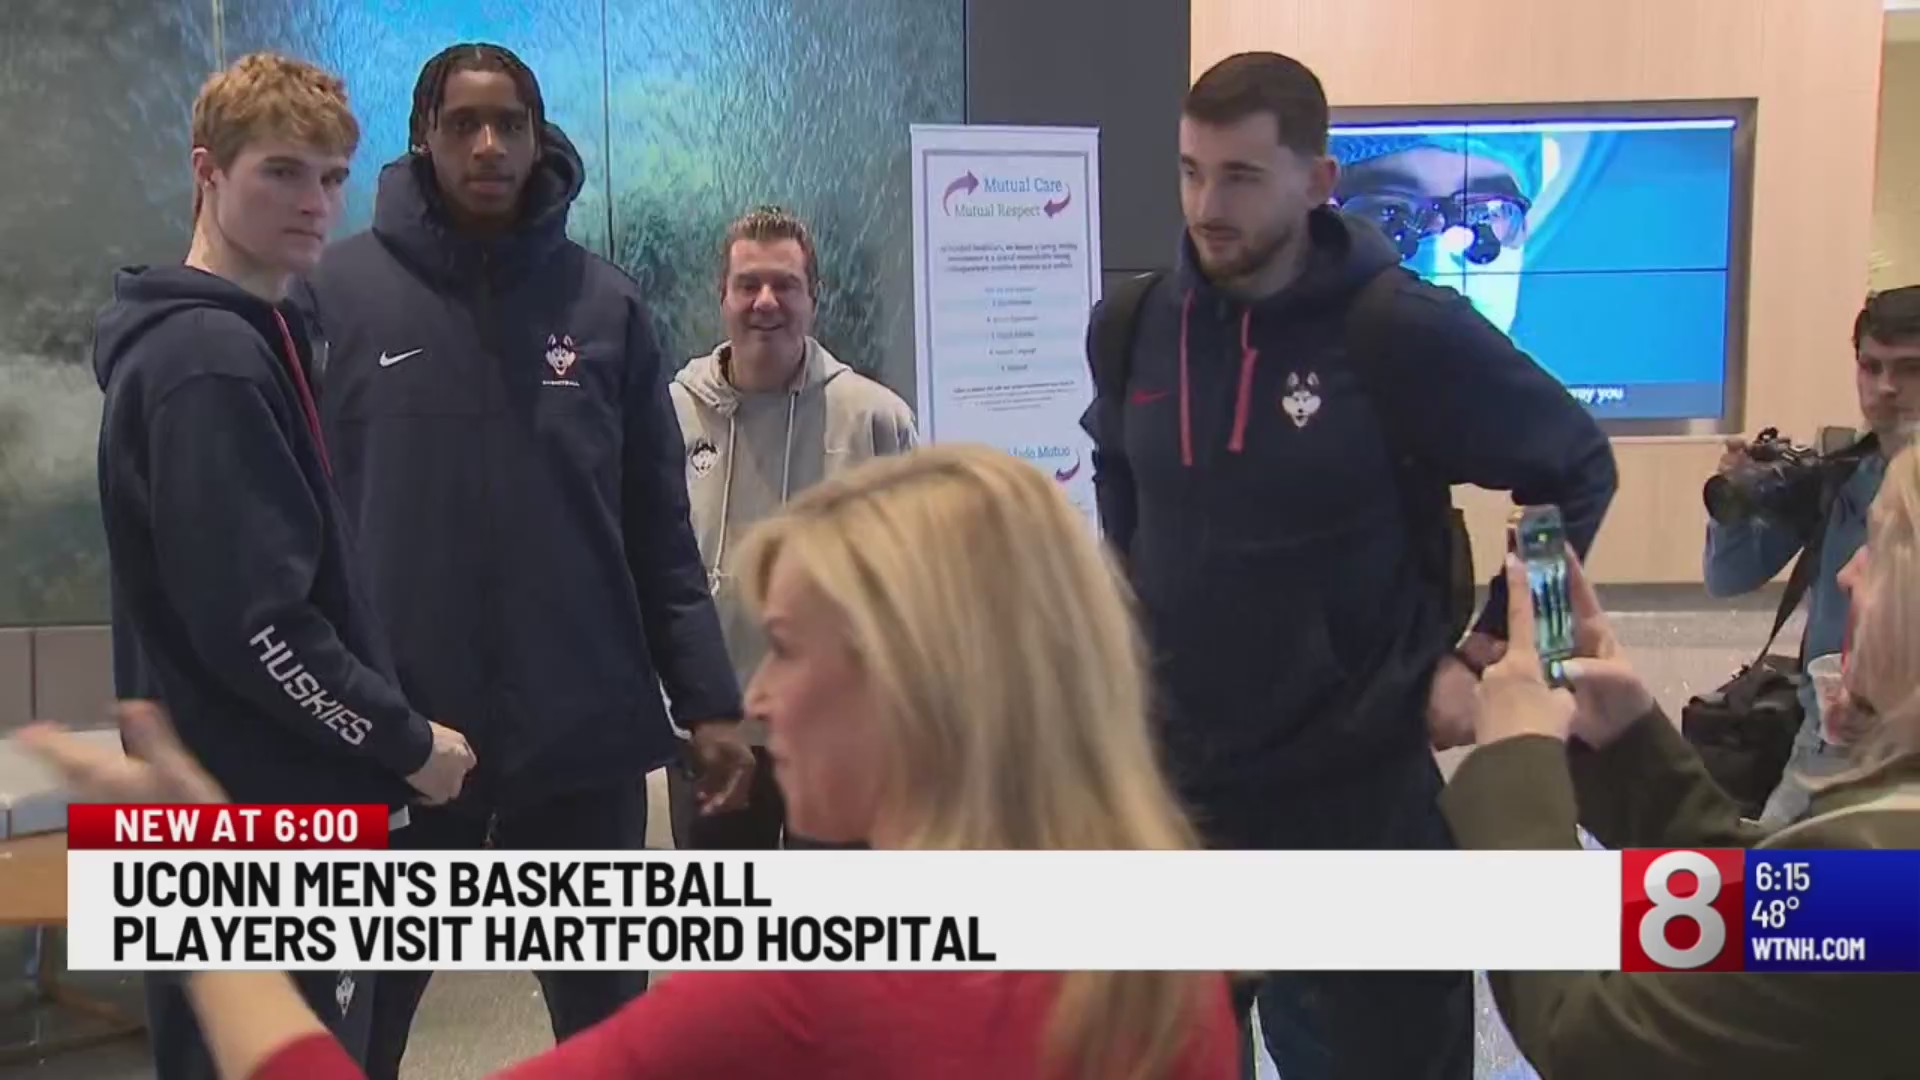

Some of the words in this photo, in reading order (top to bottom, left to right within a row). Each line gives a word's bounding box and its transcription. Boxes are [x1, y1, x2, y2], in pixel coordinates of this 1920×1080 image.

[984, 176, 1029, 193] Mutual
[1034, 177, 1063, 193] Care
[955, 203, 994, 217] Mutual
[998, 204, 1040, 221] Respect
[1597, 387, 1624, 404] you
[249, 624, 373, 746] HUSKIES
